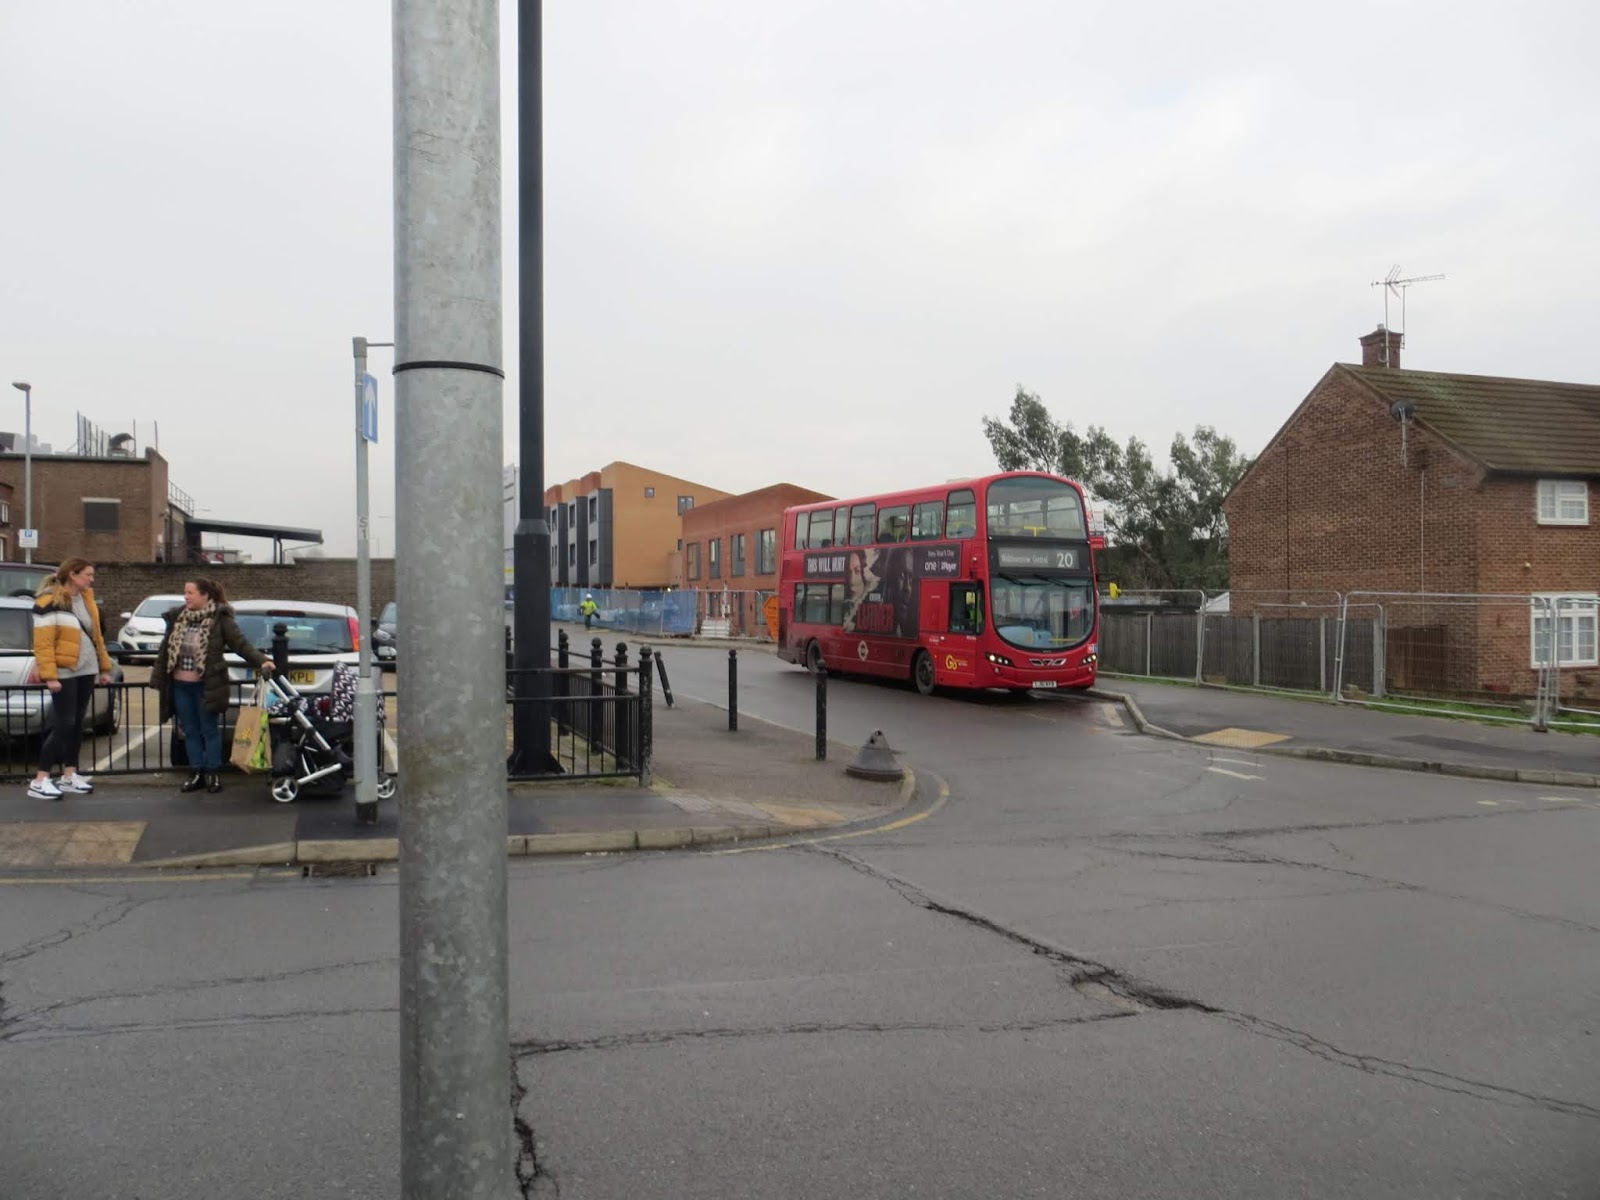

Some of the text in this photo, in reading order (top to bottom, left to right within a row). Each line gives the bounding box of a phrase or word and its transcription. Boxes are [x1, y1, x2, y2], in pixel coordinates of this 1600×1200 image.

[818, 557, 831, 572] WILL
[924, 561, 937, 571] one
[1056, 552, 1074, 569] 20
[289, 670, 313, 683] KPL
